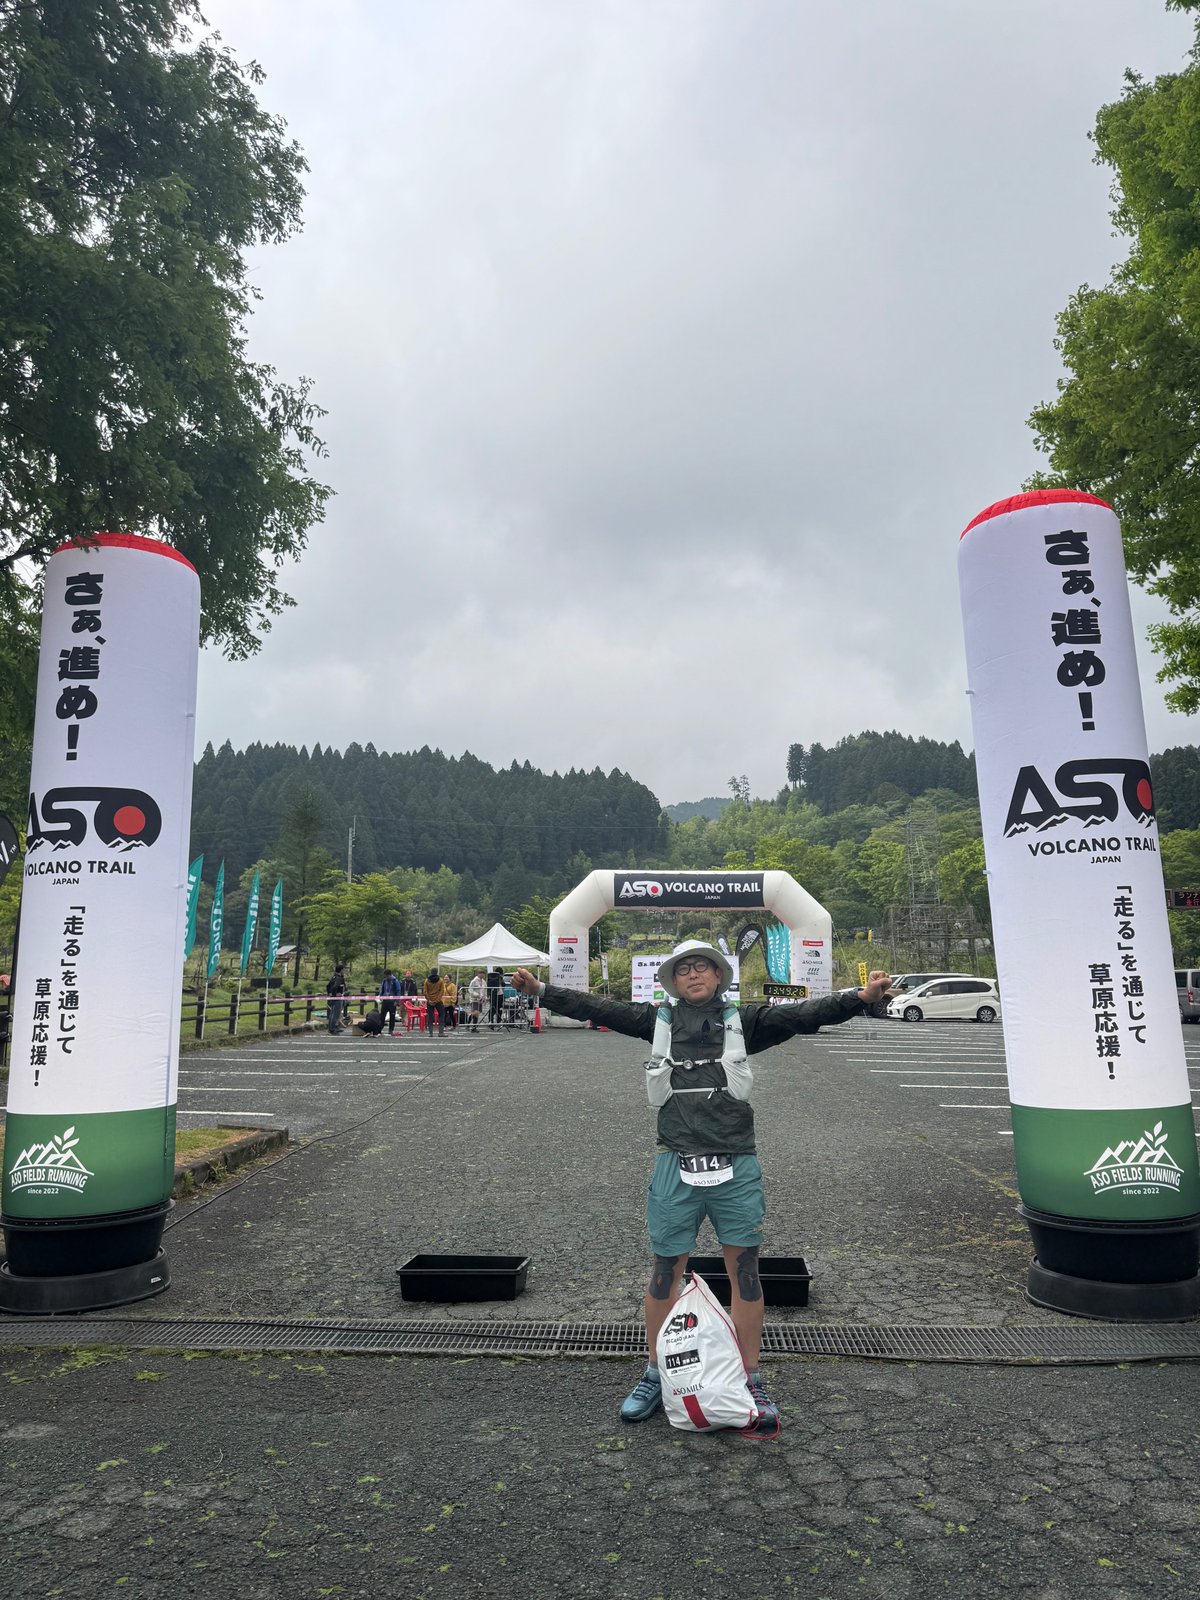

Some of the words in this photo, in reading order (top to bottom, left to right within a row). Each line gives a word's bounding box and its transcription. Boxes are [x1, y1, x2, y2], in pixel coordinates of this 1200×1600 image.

[1044, 529, 1106, 731] さぁ、進め！
[55, 572, 108, 760] さぁ、進め！
[1003, 758, 1156, 838] ASO
[1027, 837, 1121, 857] VOLCANO
[1124, 836, 1156, 853] TRAIL
[25, 860, 82, 877] VOLCANO
[88, 860, 136, 875] TRAIL
[1090, 855, 1122, 865] JAPAN
[52, 877, 80, 886] JAPAN
[619, 880, 663, 898] ASO
[664, 882, 724, 894] VOLCANO
[727, 882, 761, 893] TRAIL
[1113, 885, 1148, 1045] 「走る」を通じて
[57, 905, 87, 1055] 「走る」を通じて
[30, 978, 53, 1087] 草原応援！
[1088, 964, 1122, 1081] 草原応援！
[690, 1155, 720, 1172] 114
[11, 1171, 22, 1187] ASO
[22, 1168, 46, 1183] FIELDS
[47, 1168, 89, 1188] RUNNING
[1090, 1171, 1111, 1189] ASO
[1111, 1166, 1143, 1183] FIELDS
[1145, 1167, 1181, 1187] RUNNING
[1143, 1187, 1160, 1195] 2022
[668, 1356, 681, 1368] 114
[673, 1387, 687, 1396] ASO
[686, 1383, 704, 1394] MILK
